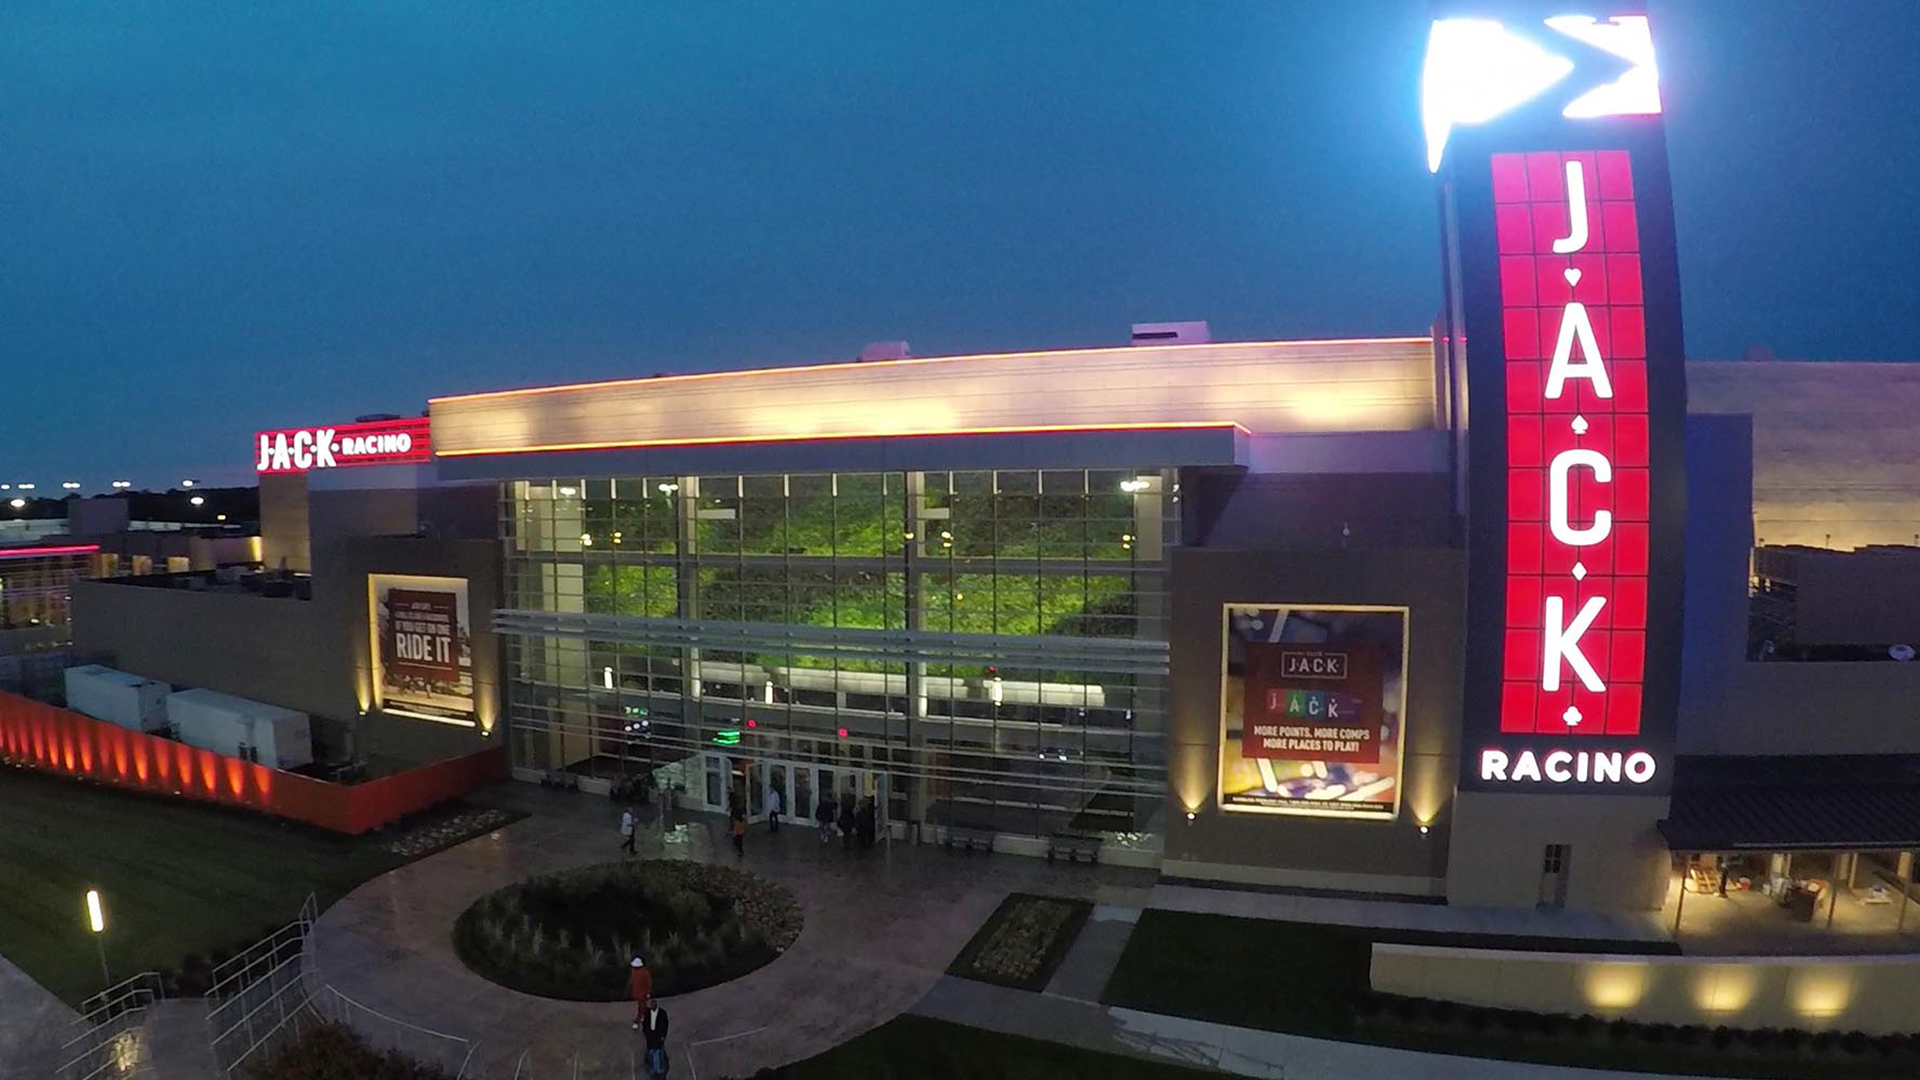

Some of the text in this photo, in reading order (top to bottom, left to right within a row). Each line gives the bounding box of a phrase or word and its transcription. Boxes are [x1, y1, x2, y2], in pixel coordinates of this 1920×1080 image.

[1542, 161, 1614, 694] JACK
[256, 428, 413, 471] JACK RACINO
[396, 633, 452, 663] RIDE IT
[1288, 657, 1338, 674] JACK
[1253, 725, 1278, 736] MORE
[1314, 727, 1338, 739] MORE
[1339, 729, 1371, 740] COMPS
[1263, 738, 1360, 753] MORE PLACES TO PLAY!
[1481, 749, 1657, 784] RACINO
